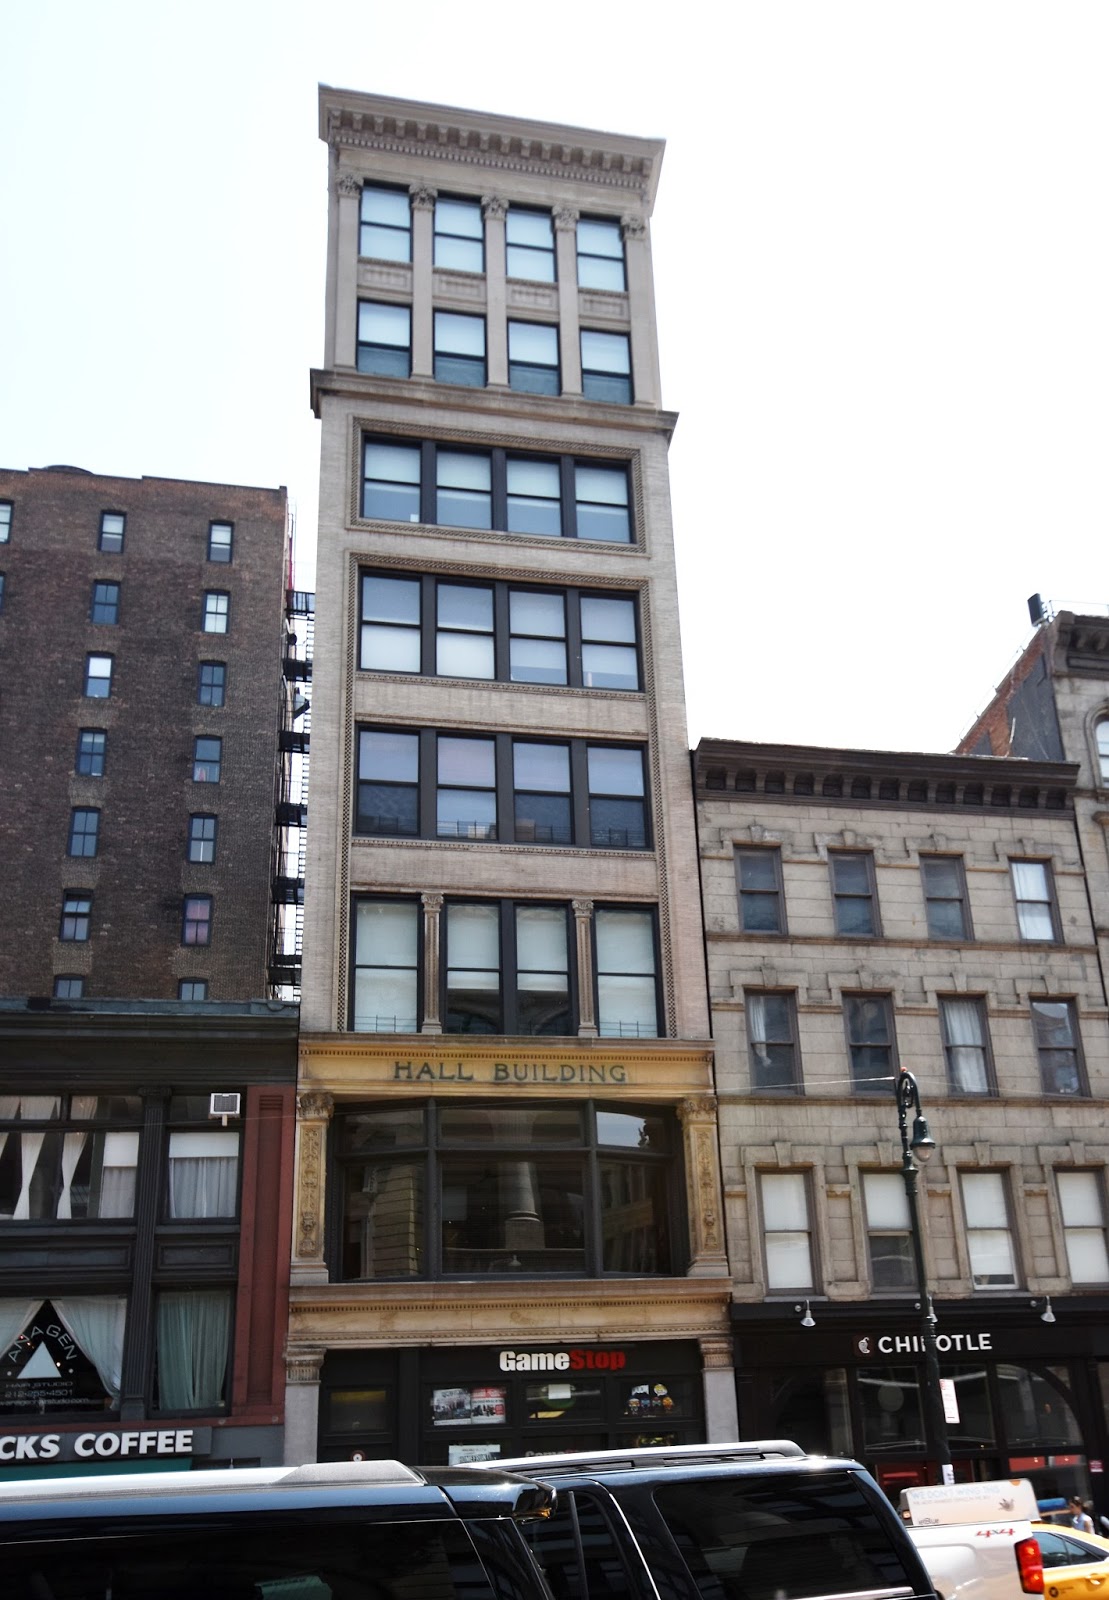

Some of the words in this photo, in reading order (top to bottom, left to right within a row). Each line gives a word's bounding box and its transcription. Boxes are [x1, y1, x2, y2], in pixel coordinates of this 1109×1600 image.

[394, 1061, 474, 1081] HALL
[494, 1063, 626, 1083] BUILDING
[8, 1324, 78, 1363] ANAGEN
[499, 1349, 626, 1371] GameStop
[0, 1434, 60, 1460] CKS
[74, 1430, 193, 1457] COFFEE
